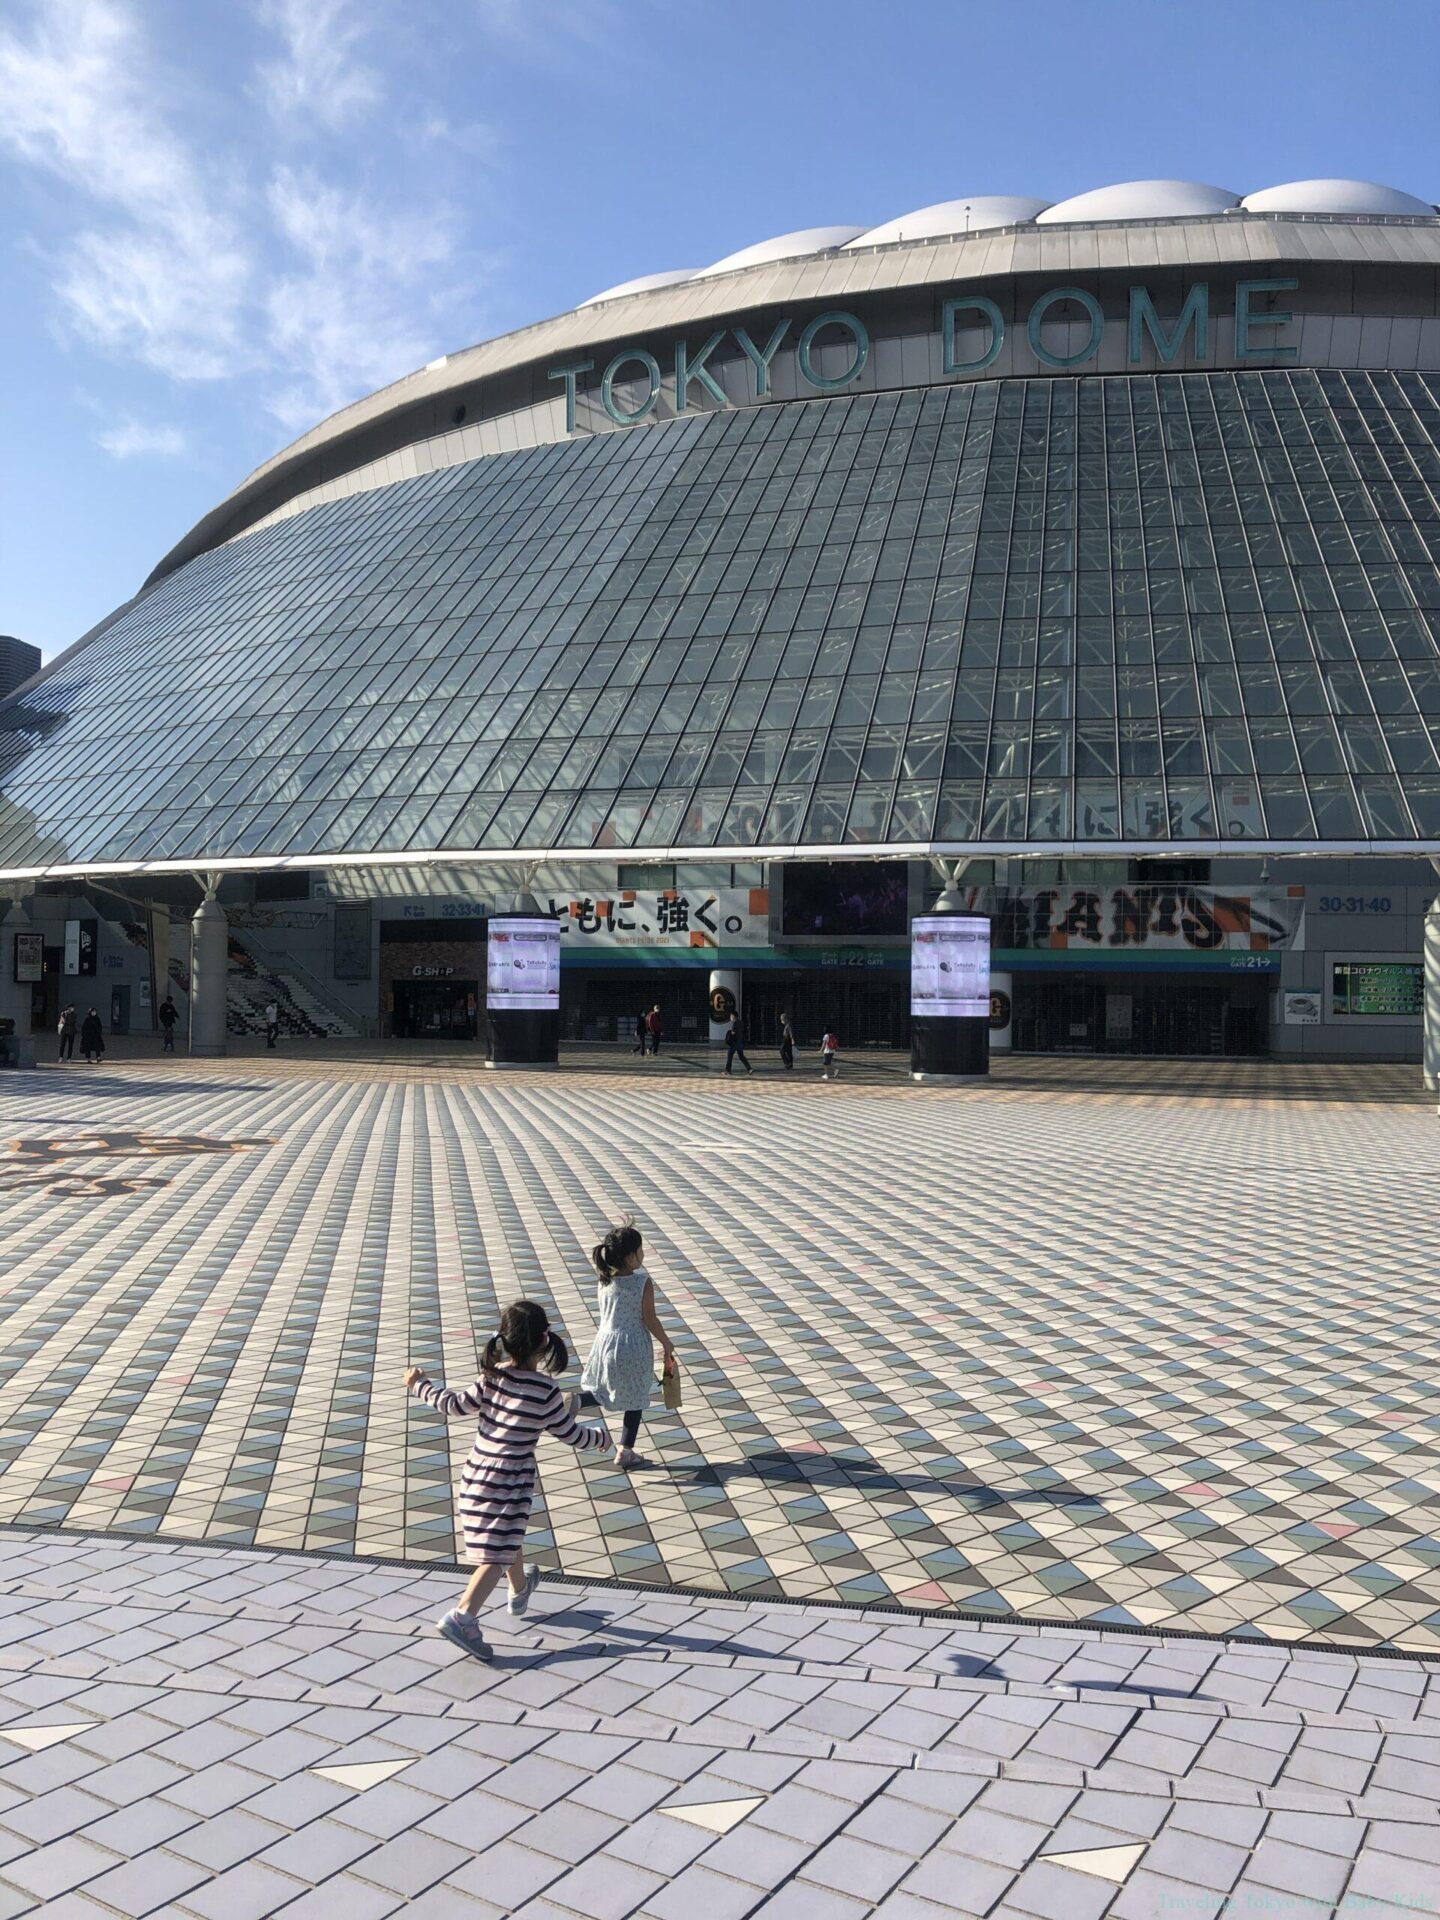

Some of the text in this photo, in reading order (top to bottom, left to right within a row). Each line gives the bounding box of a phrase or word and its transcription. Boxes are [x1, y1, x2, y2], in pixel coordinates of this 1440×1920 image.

[547, 277, 1299, 434] TOKYO DOME
[848, 951, 864, 966] 22
[1247, 956, 1261, 968] 21
